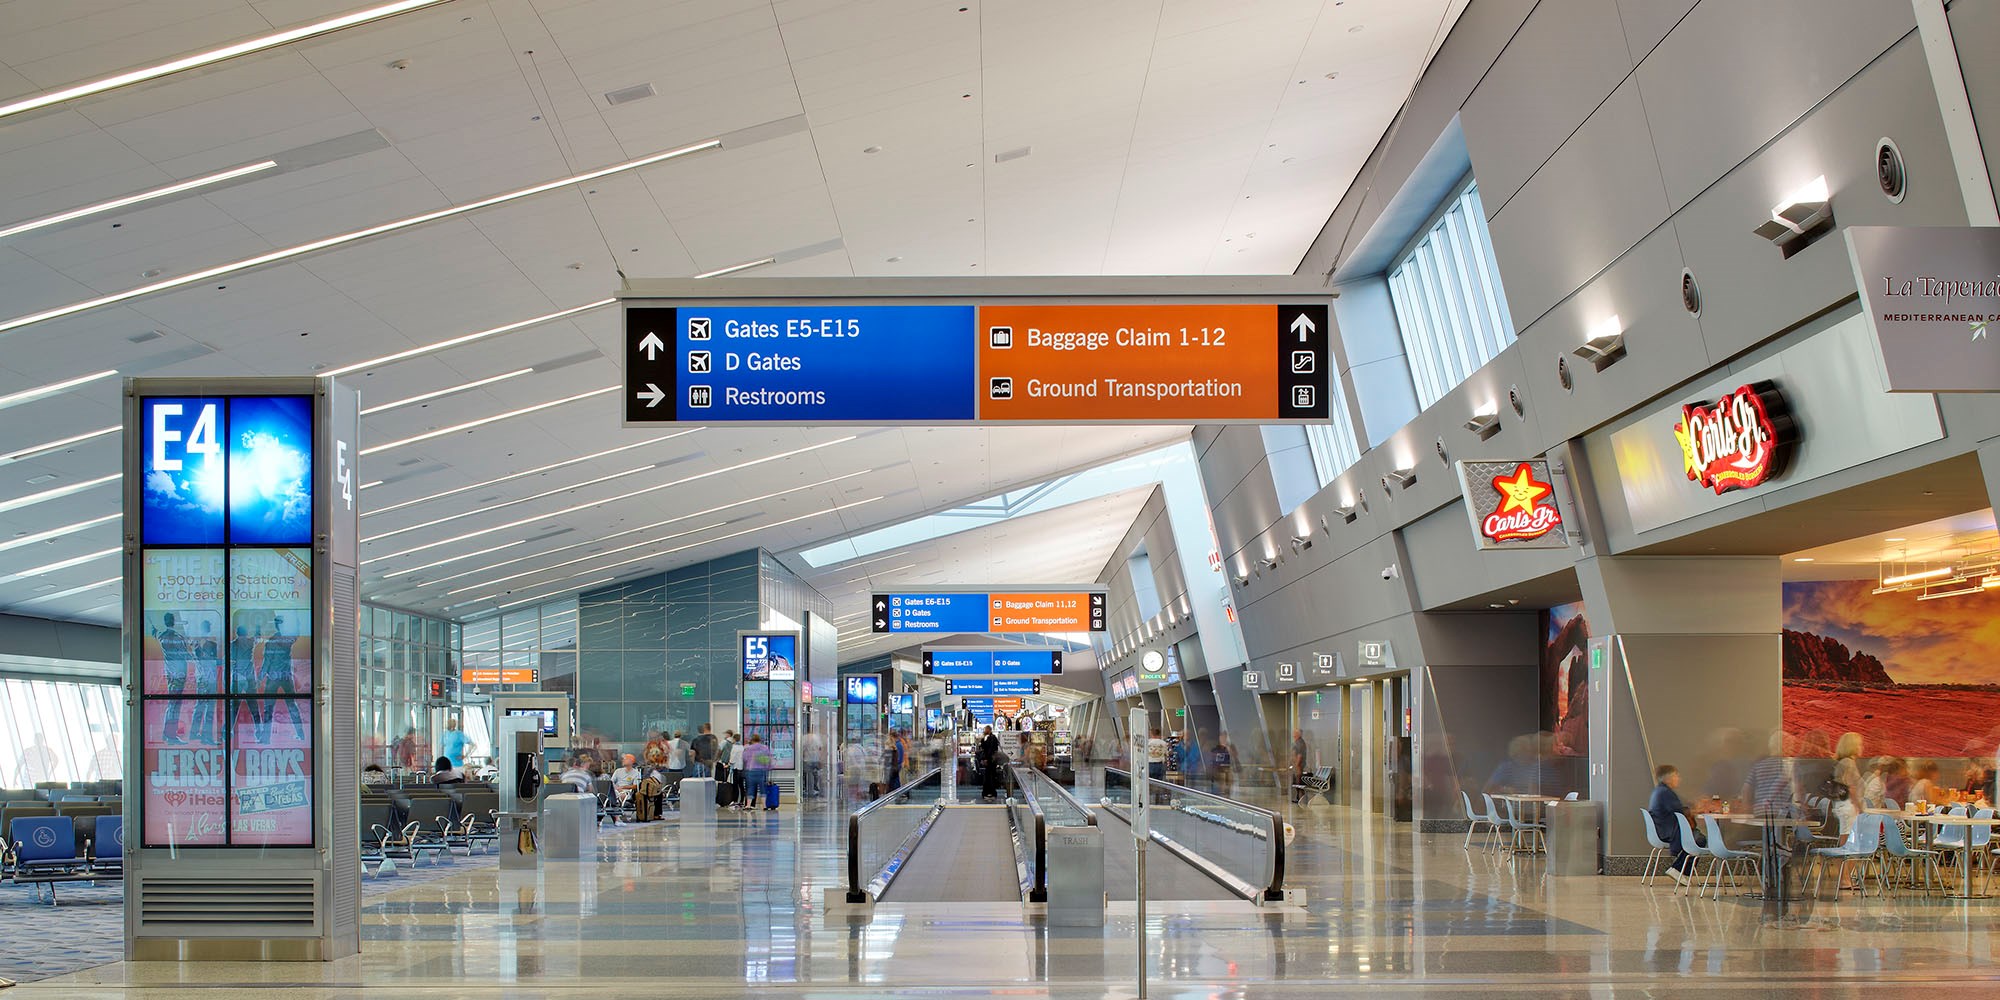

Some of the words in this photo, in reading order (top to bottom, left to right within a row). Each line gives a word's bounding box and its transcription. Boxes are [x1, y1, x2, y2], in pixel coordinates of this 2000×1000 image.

[1883, 274, 1913, 298] La
[725, 317, 779, 339] Gates
[786, 317, 860, 339] E5-E15
[1884, 314, 1984, 322] MEDITERRANEAN
[1027, 327, 1109, 352] Baggage
[1115, 327, 1171, 348] Claim
[1179, 327, 1226, 348] 1-12
[725, 352, 741, 372] D
[746, 352, 802, 372] Gates
[725, 386, 827, 406] Restrooms
[1027, 378, 1097, 399] Ground
[1104, 378, 1242, 402] Transportation
[152, 403, 221, 471] E4
[1689, 401, 1736, 472] Carl's
[1732, 393, 1767, 459] Jr.
[336, 439, 353, 511] E4
[1484, 510, 1532, 536] Carl's
[1531, 506, 1559, 528] Jr.
[284, 551, 309, 574] FREE
[157, 575, 195, 586] 1,500
[236, 574, 296, 586] Stations
[157, 591, 171, 600] or
[176, 590, 224, 600] Create
[230, 588, 263, 600] Your
[266, 588, 300, 599] Own
[904, 598, 924, 606] Gates
[925, 598, 951, 606] E6-E15
[904, 609, 911, 617] D
[912, 609, 932, 617] Gates
[1005, 600, 1034, 610] Baggage
[1034, 600, 1054, 608] Claim
[904, 620, 939, 628] Restrooms
[1005, 616, 1031, 625] Ground
[1032, 616, 1078, 626] Transportation
[746, 637, 768, 659] E5
[848, 677, 862, 692] E6
[892, 695, 902, 705] E7
[151, 749, 241, 787] JERSEY
[246, 749, 305, 787] BOYS
[250, 818, 277, 833] VEGAS
[1063, 837, 1089, 845] TRASH
